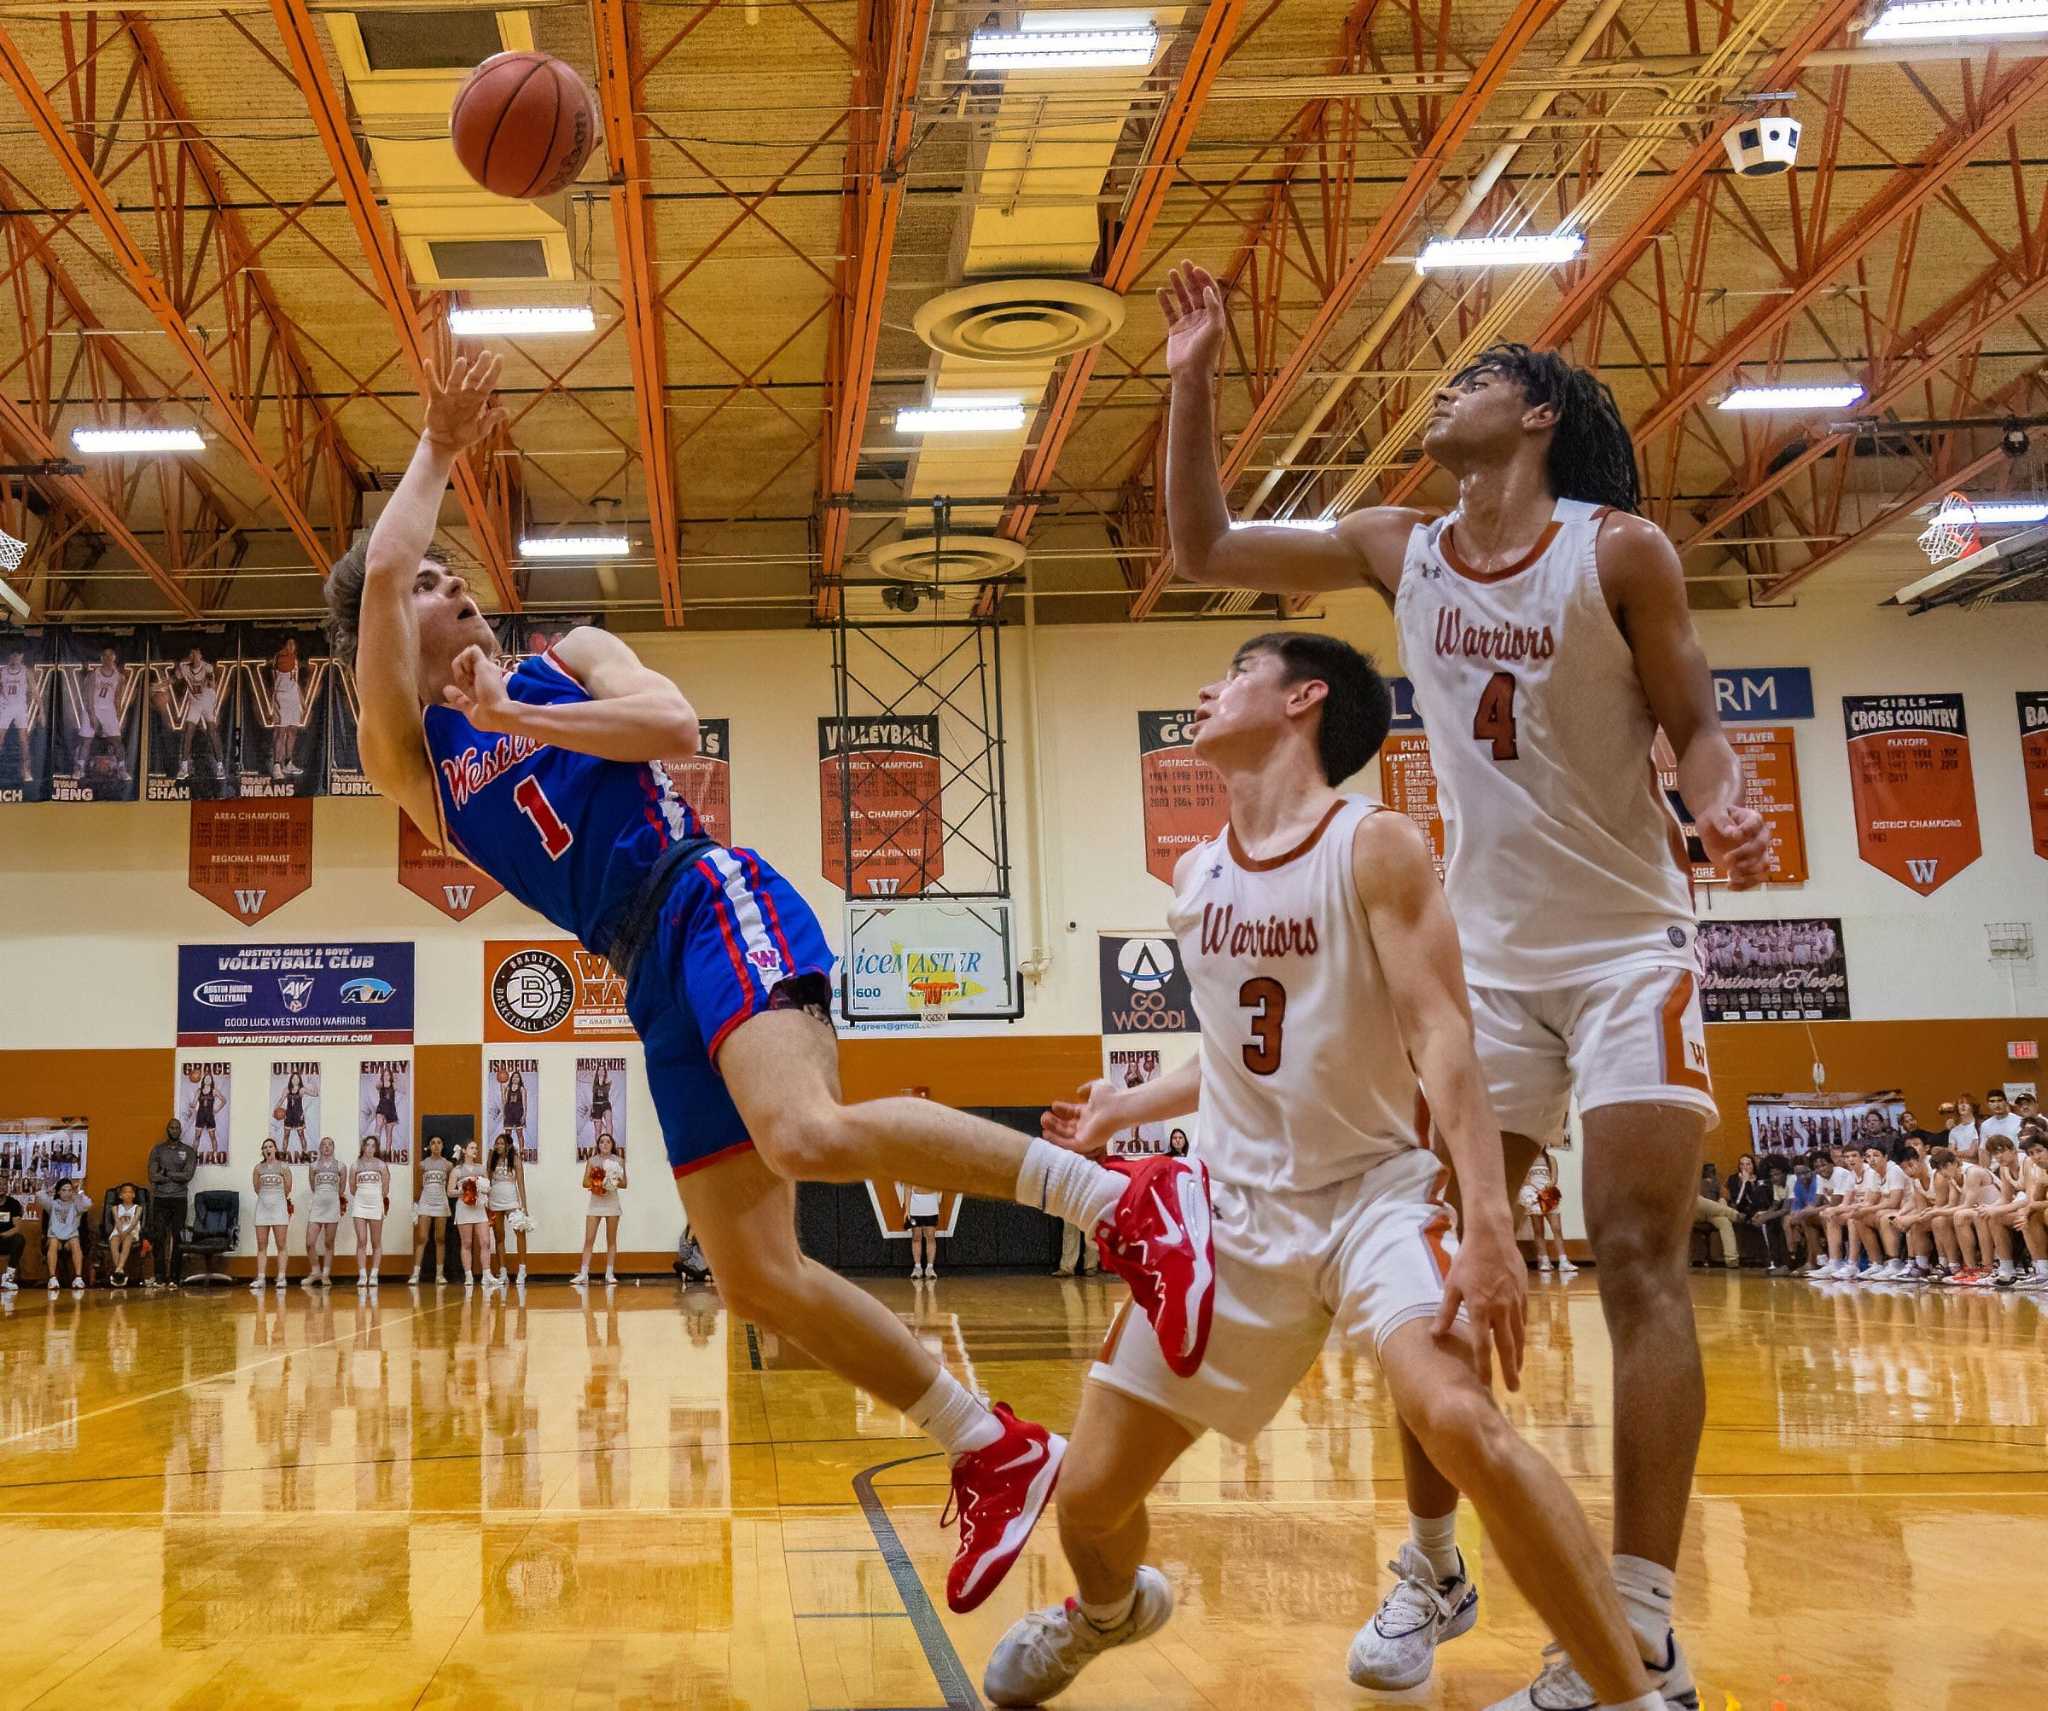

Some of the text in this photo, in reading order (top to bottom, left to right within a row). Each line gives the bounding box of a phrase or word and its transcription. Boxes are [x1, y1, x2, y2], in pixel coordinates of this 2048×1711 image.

[1435, 606, 1555, 660] Warriors
[1879, 698, 1927, 707] GIRLS
[1473, 672, 1519, 760] 4
[1851, 708, 1958, 731] CROSS COUNTRY
[52, 788, 94, 800] JENG
[148, 786, 190, 800] SHAH
[240, 784, 296, 797] MEANS
[214, 811, 290, 821] AREA CHAMPIONS
[513, 775, 574, 861] 1
[1909, 819, 1962, 829] CHAMPIONS
[211, 854, 291, 863] REGIONAL FINALIST
[1905, 859, 1938, 884] W
[234, 889, 267, 914] W
[443, 885, 476, 911] W
[1201, 902, 1319, 958] Warriors
[218, 955, 375, 971] VOLLEYBALL CLUB
[509, 953, 559, 970] BRADLEY
[208, 993, 247, 1004] VOLLEYBALL
[1130, 992, 1166, 1011] GO
[495, 987, 572, 1031] BASKETBALL ACADEMY
[224, 1016, 367, 1027] GOOD LUCK WESTWOOD WARRIORS
[1239, 976, 1287, 1076] 3
[217, 1034, 373, 1045] WWW.AUSTINSPORTSCENTER.COM
[576, 1058, 626, 1071] MACKENZIE
[1110, 1051, 1160, 1065] HARPER
[183, 1062, 231, 1076] GRACE
[272, 1062, 320, 1075] OLIVIA
[360, 1061, 409, 1074] EMILY
[488, 1060, 538, 1072] ISABELLA
[1115, 1140, 1163, 1153] ZOLL
[276, 1150, 318, 1164] ANG
